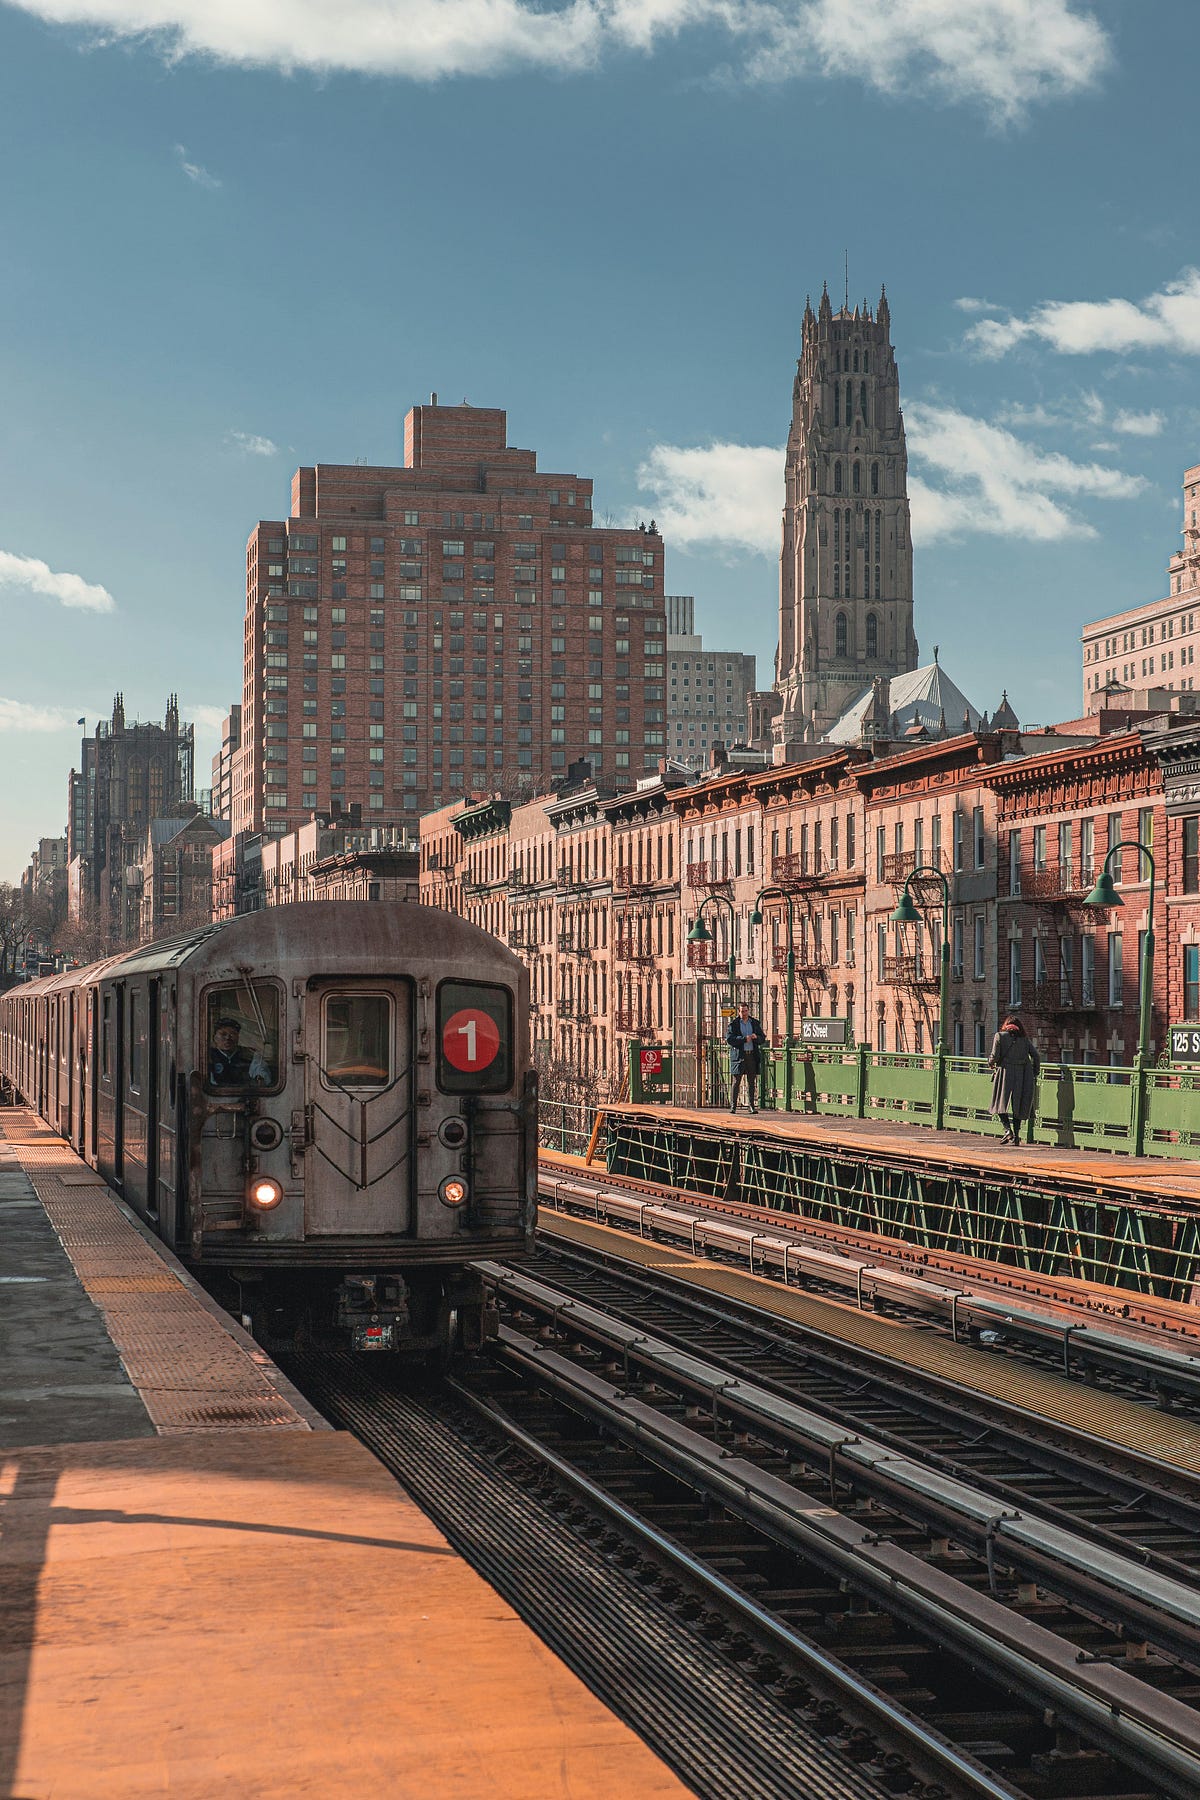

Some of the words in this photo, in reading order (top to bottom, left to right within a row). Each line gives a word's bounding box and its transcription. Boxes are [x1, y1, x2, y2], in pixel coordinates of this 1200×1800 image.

[458, 1020, 477, 1061] 1
[803, 1023, 812, 1038] 125
[812, 1023, 828, 1038] Street
[1172, 1033, 1189, 1053] 125
[1192, 1033, 1200, 1053] S
